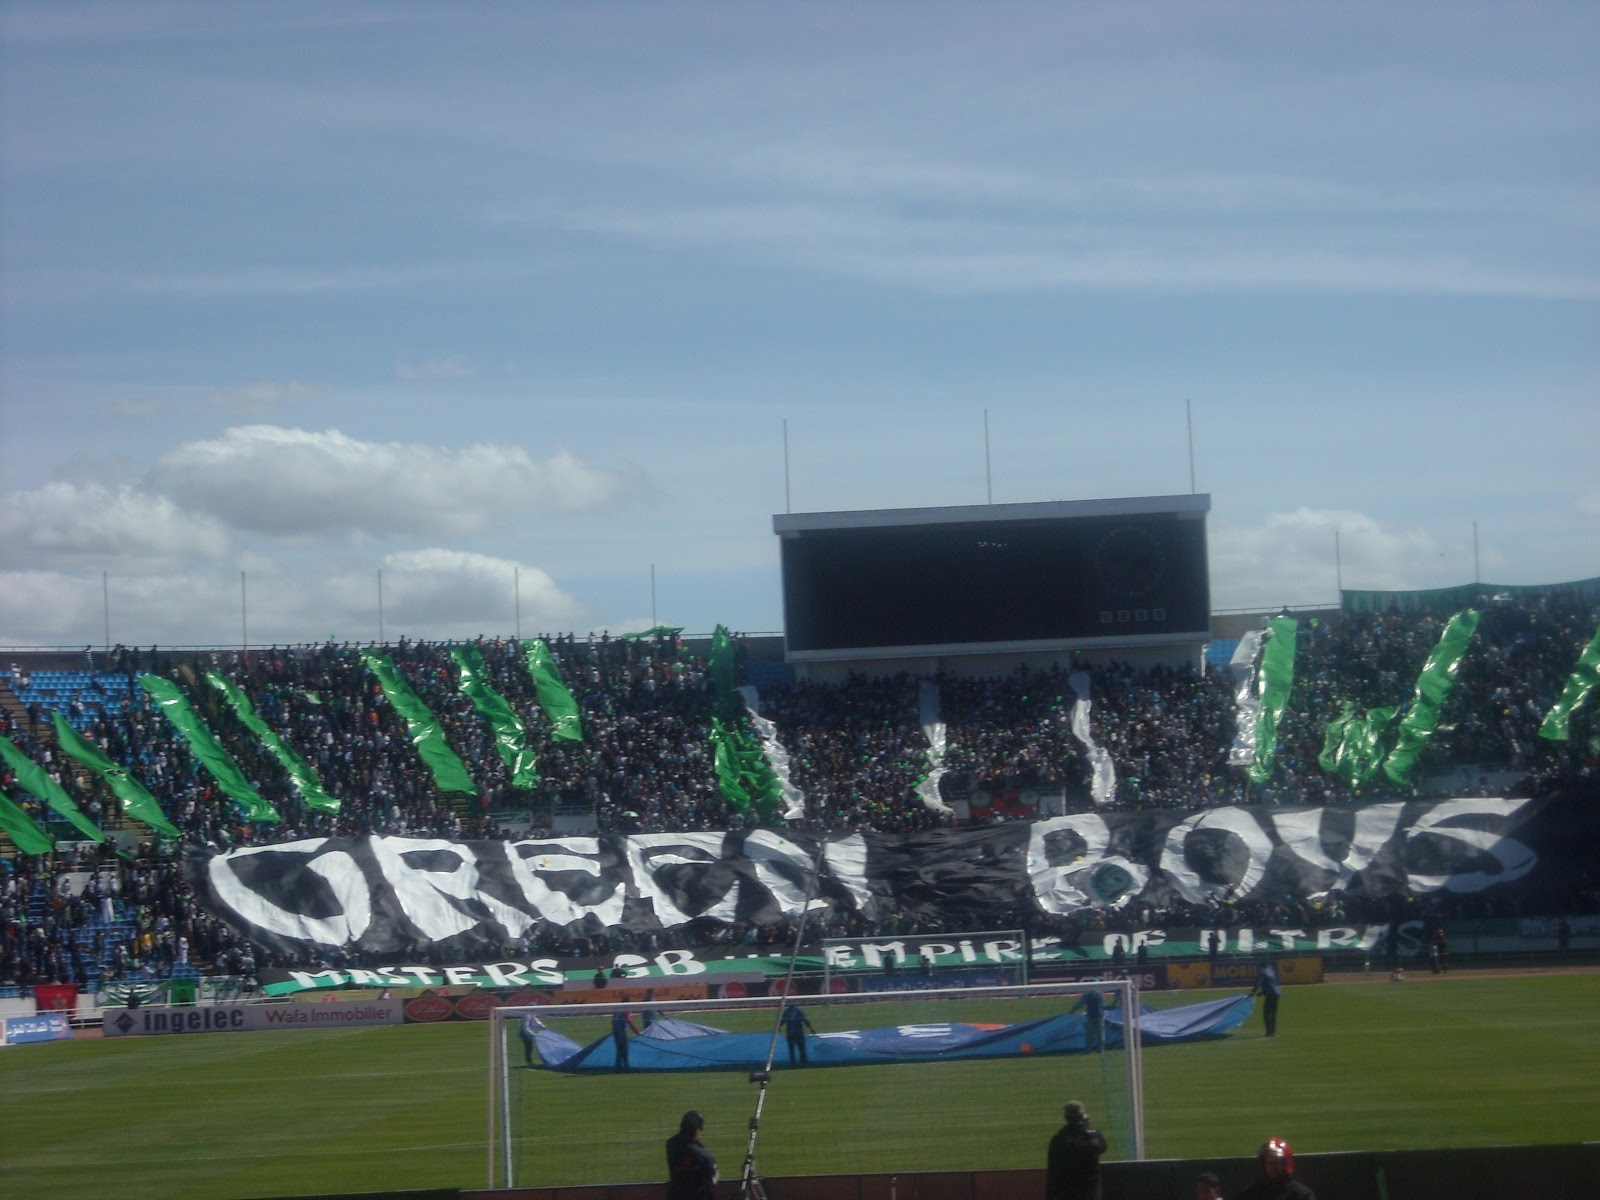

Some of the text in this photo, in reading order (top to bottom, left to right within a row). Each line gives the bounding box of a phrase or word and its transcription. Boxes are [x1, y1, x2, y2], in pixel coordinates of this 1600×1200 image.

[1027, 798, 1538, 915] BOYS
[288, 959, 565, 988] MASTERS
[613, 950, 707, 979] GB
[822, 936, 1063, 968] EMPIRE
[1103, 929, 1167, 956] OF
[144, 1009, 244, 1032] ingelec
[265, 1009, 308, 1024] Wafa
[311, 1006, 392, 1022] Immobilier
